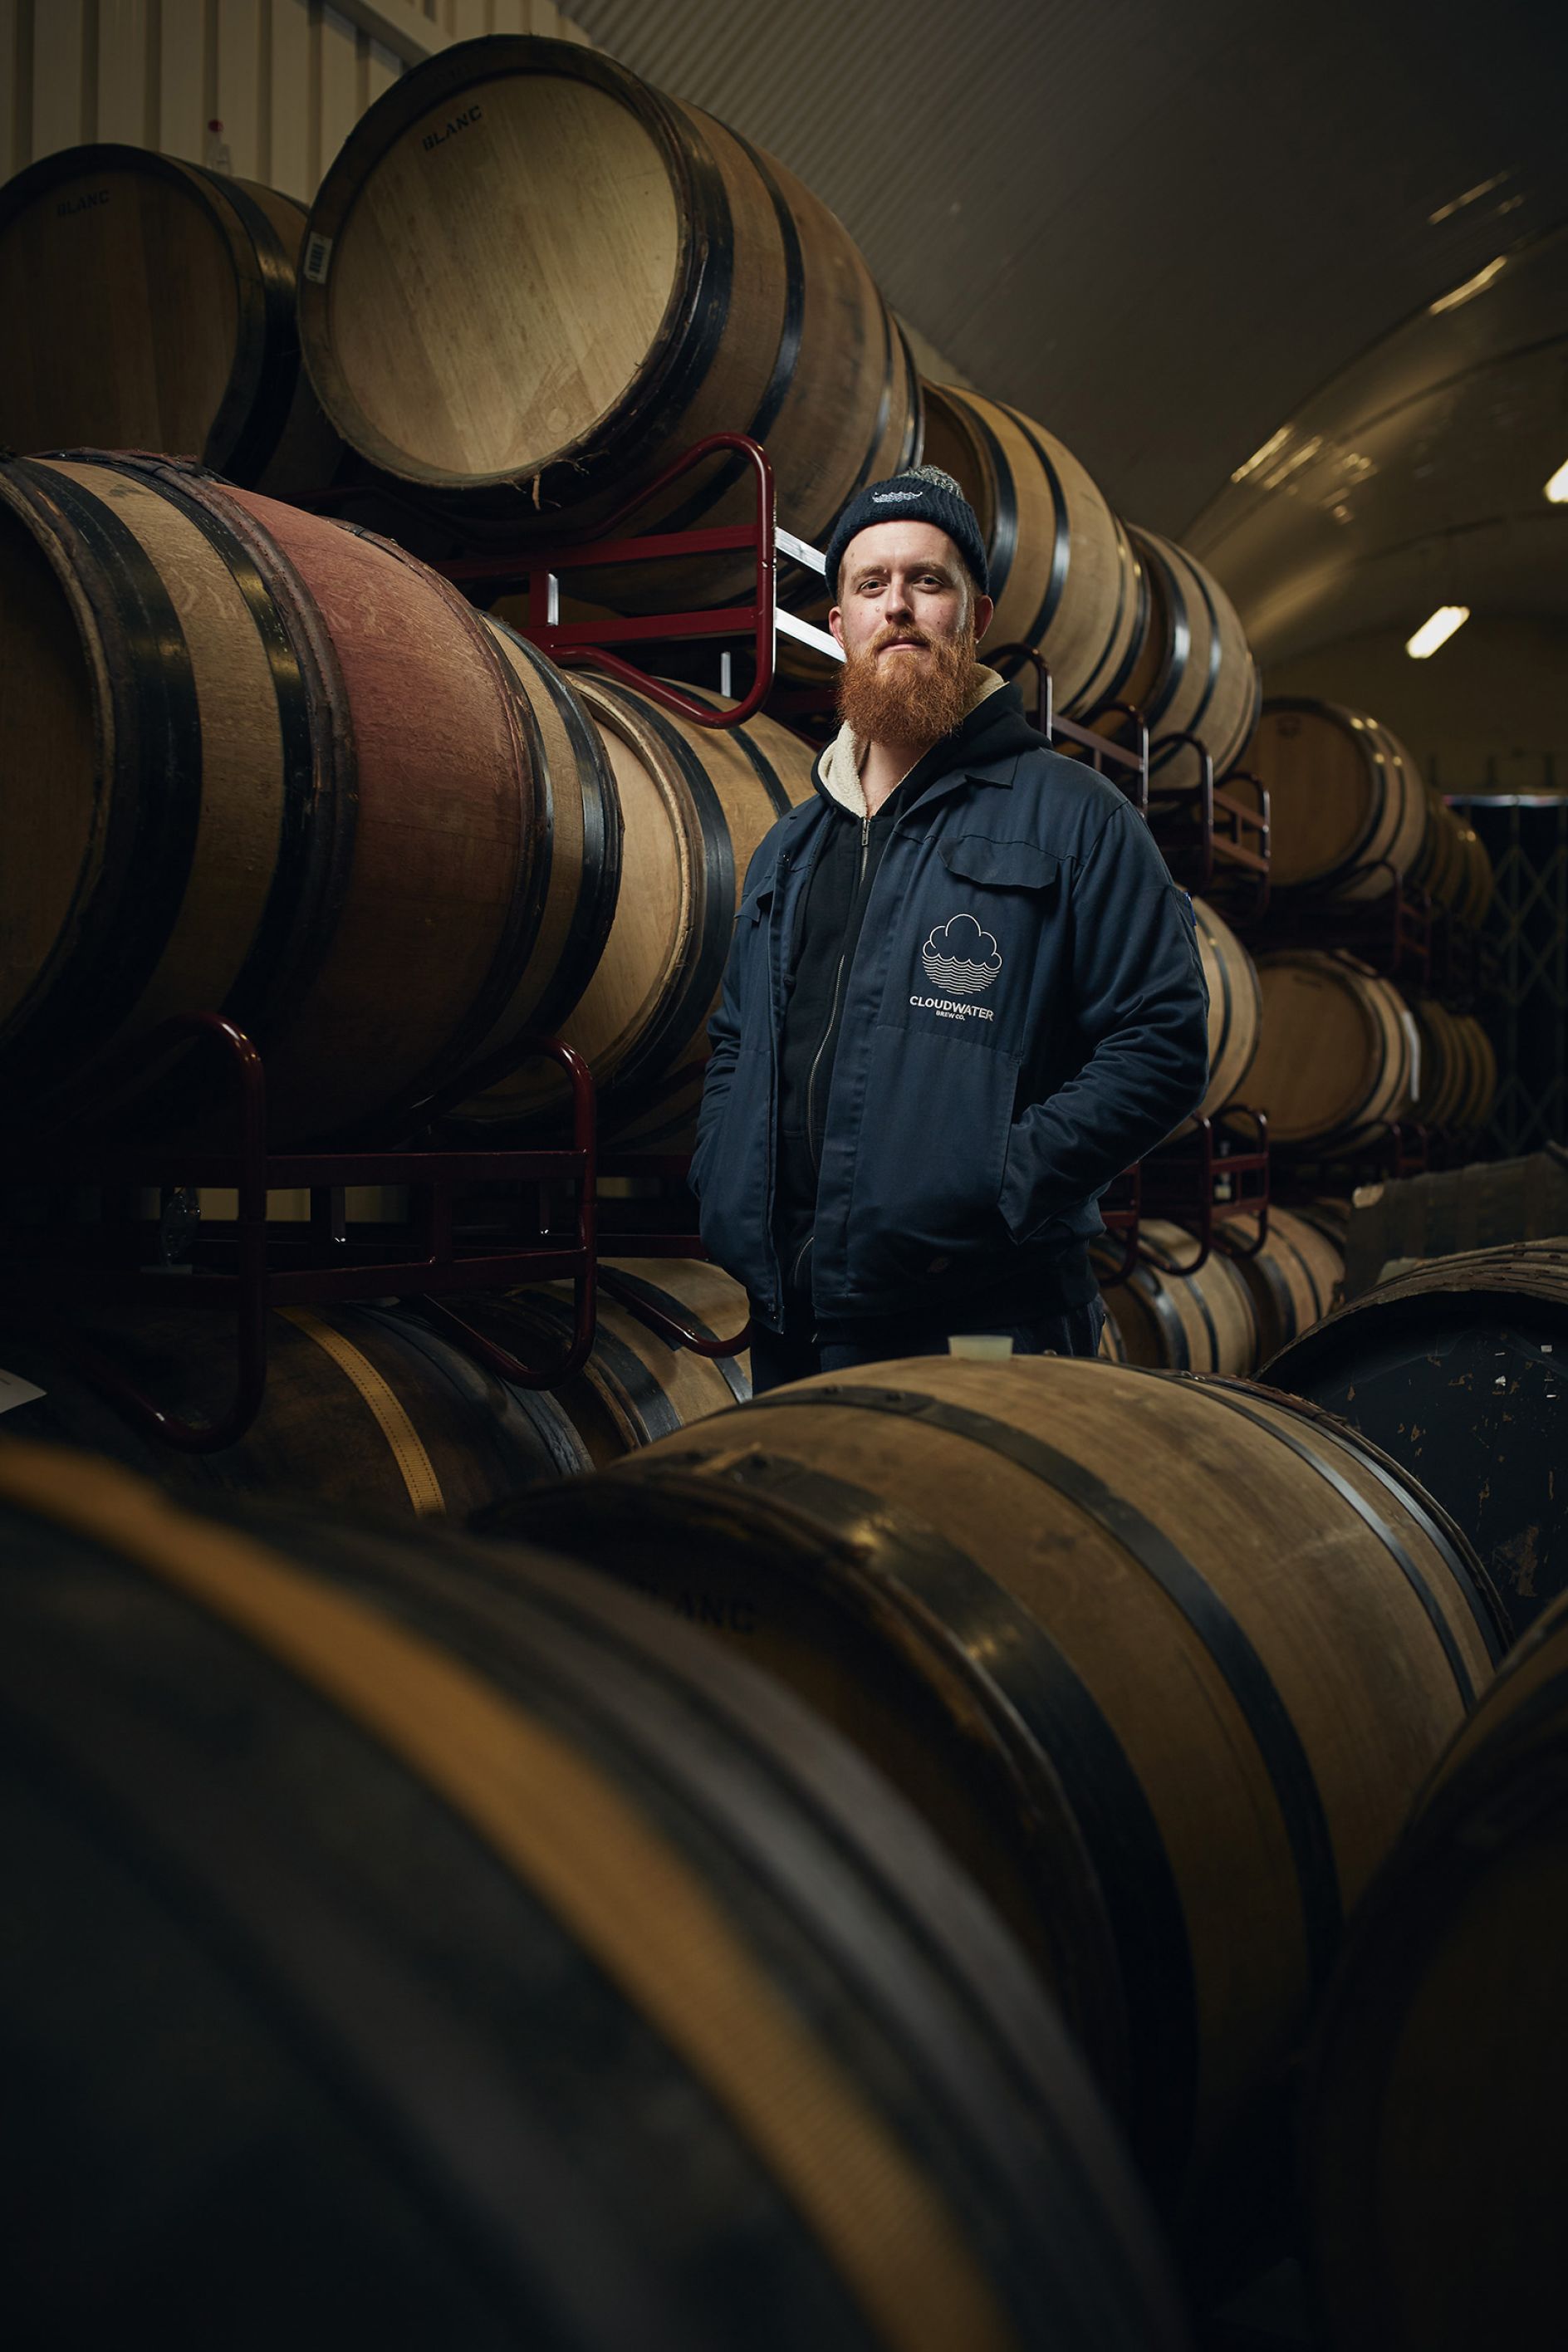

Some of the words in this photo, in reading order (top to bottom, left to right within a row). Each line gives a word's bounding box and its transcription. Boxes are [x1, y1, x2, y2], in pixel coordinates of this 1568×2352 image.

[422, 105, 482, 151] BLANC
[57, 190, 109, 216] BLANC
[909, 996, 994, 1022] CLOUDWATER
[935, 1010, 955, 1019] BREW
